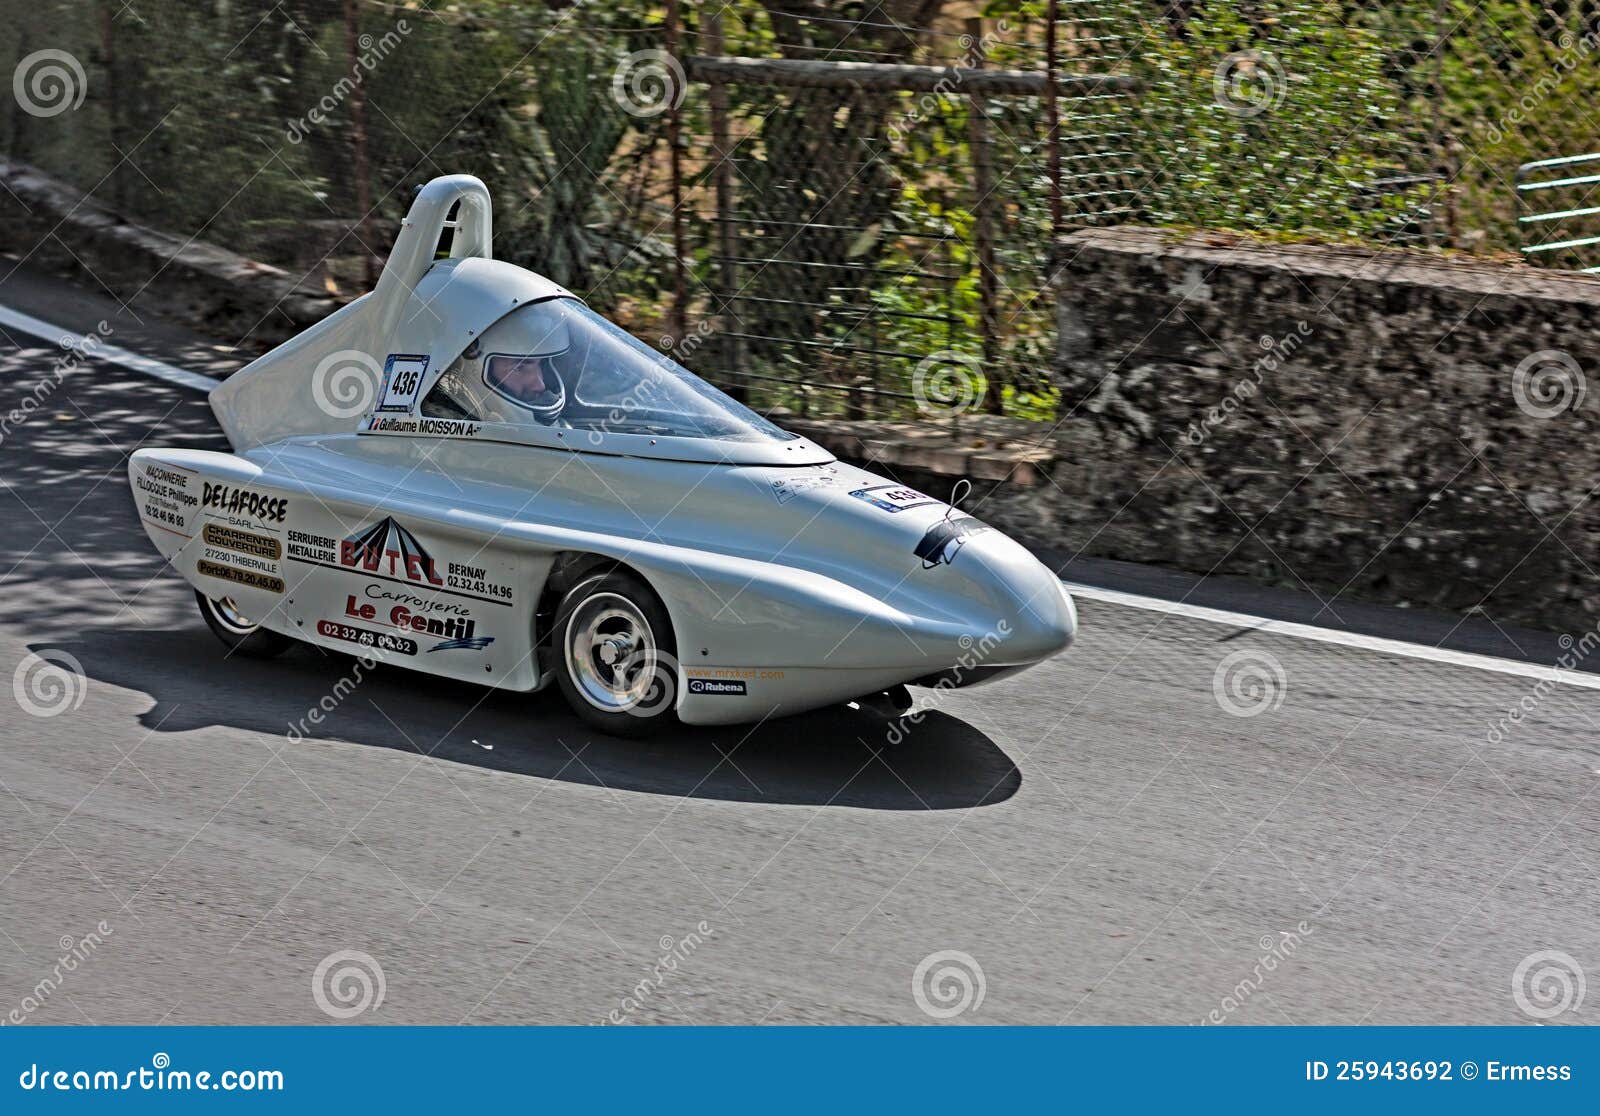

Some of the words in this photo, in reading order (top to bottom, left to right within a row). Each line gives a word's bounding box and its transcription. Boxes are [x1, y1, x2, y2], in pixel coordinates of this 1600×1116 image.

[392, 371, 419, 396] 436
[380, 418, 417, 433] Guillaume
[419, 420, 465, 436] MOISSON
[202, 481, 289, 523] DELAFOSSE
[228, 516, 255, 530] SARL
[208, 526, 276, 549] CHARPENTE
[208, 535, 276, 558] COUVERTURE
[287, 530, 337, 550] SERRURERIE
[205, 548, 230, 562] 27230
[231, 555, 277, 574] THIBERVILLE
[287, 543, 336, 563] METALLERIE
[341, 539, 444, 587] BUTEL
[448, 563, 487, 581] BERNAY
[447, 576, 513, 599] 02.32.43.14.96
[365, 584, 471, 617] Carrosserie
[345, 595, 377, 620] Le
[390, 605, 476, 640] Gentil
[324, 623, 339, 636] 02
[342, 627, 357, 640] 32
[360, 632, 375, 644] 43
[396, 639, 411, 652] 62
[705, 682, 744, 692] Rubena
